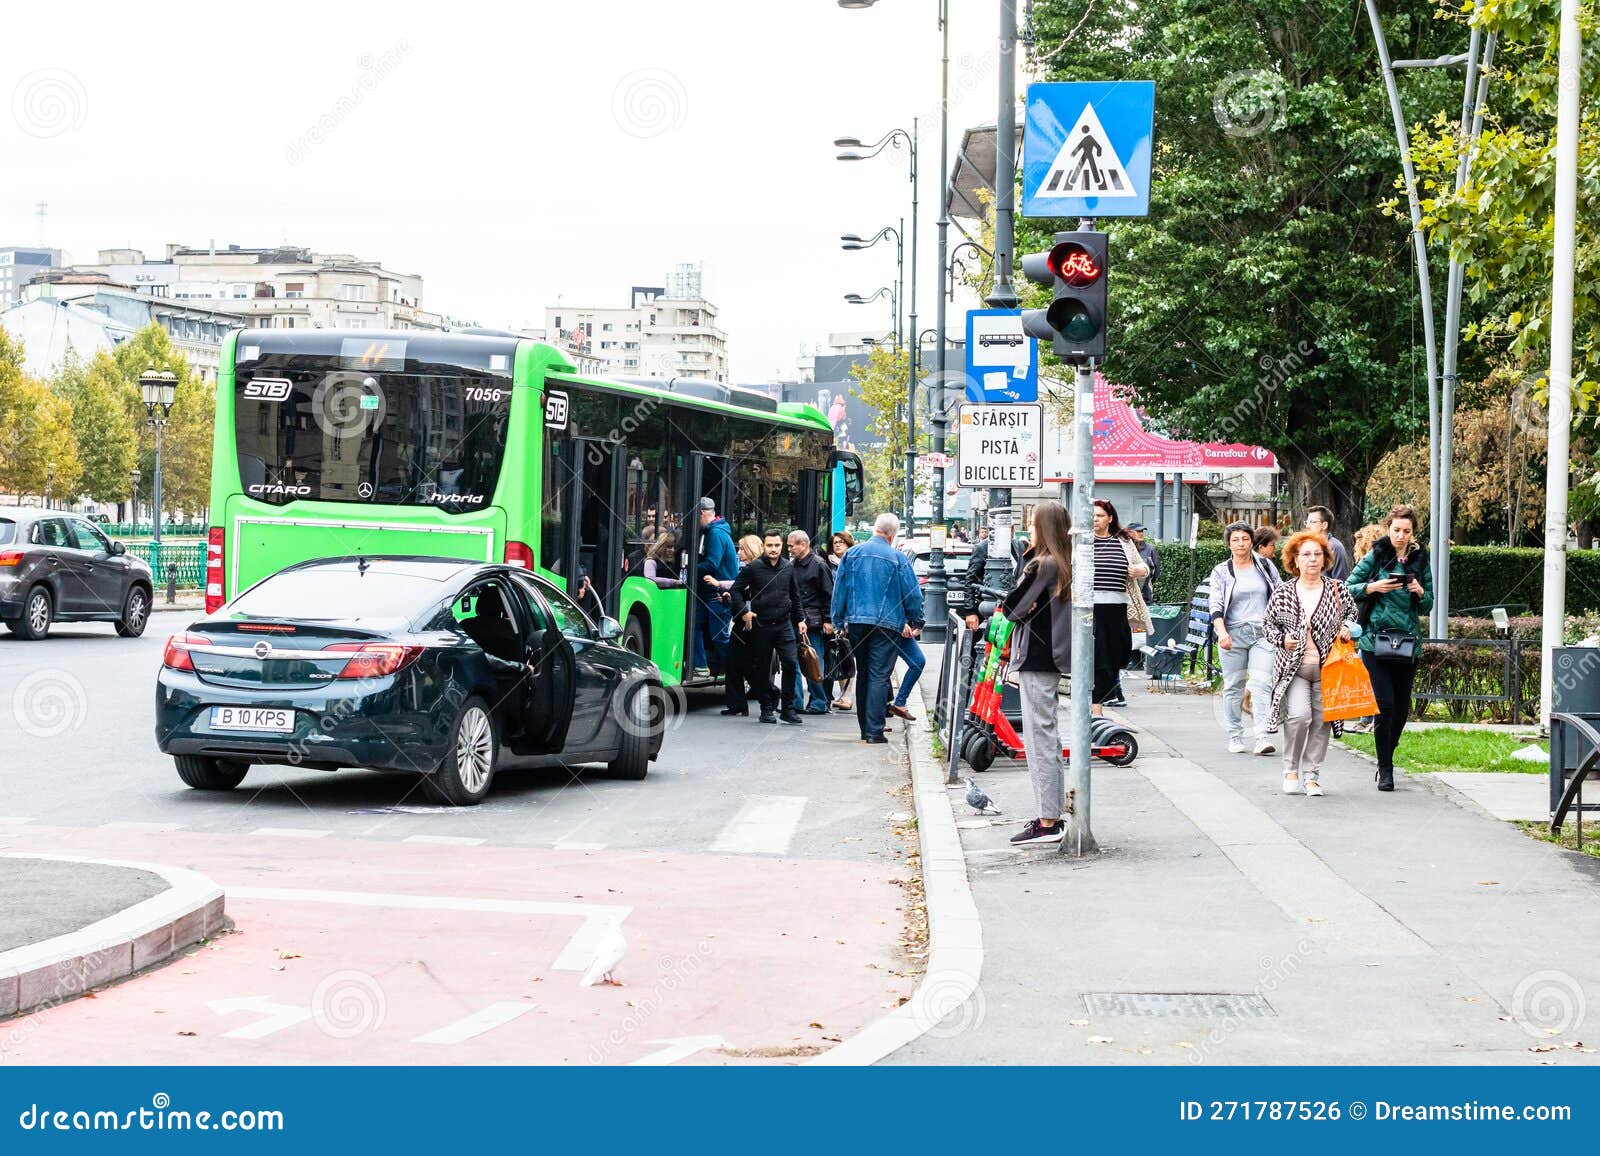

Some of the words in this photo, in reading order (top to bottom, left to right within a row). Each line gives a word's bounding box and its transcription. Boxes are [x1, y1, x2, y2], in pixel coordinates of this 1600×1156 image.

[244, 379, 292, 400] STB
[465, 387, 501, 402] 7056
[545, 394, 567, 426] STB
[981, 437, 1019, 454] PISTĂ
[1205, 448, 1247, 458] Carrefour
[965, 466, 1035, 480] BICICLETE
[430, 492, 484, 505] hybrid
[222, 709, 232, 724] B
[238, 709, 250, 725] 10
[254, 711, 286, 725] KPS
